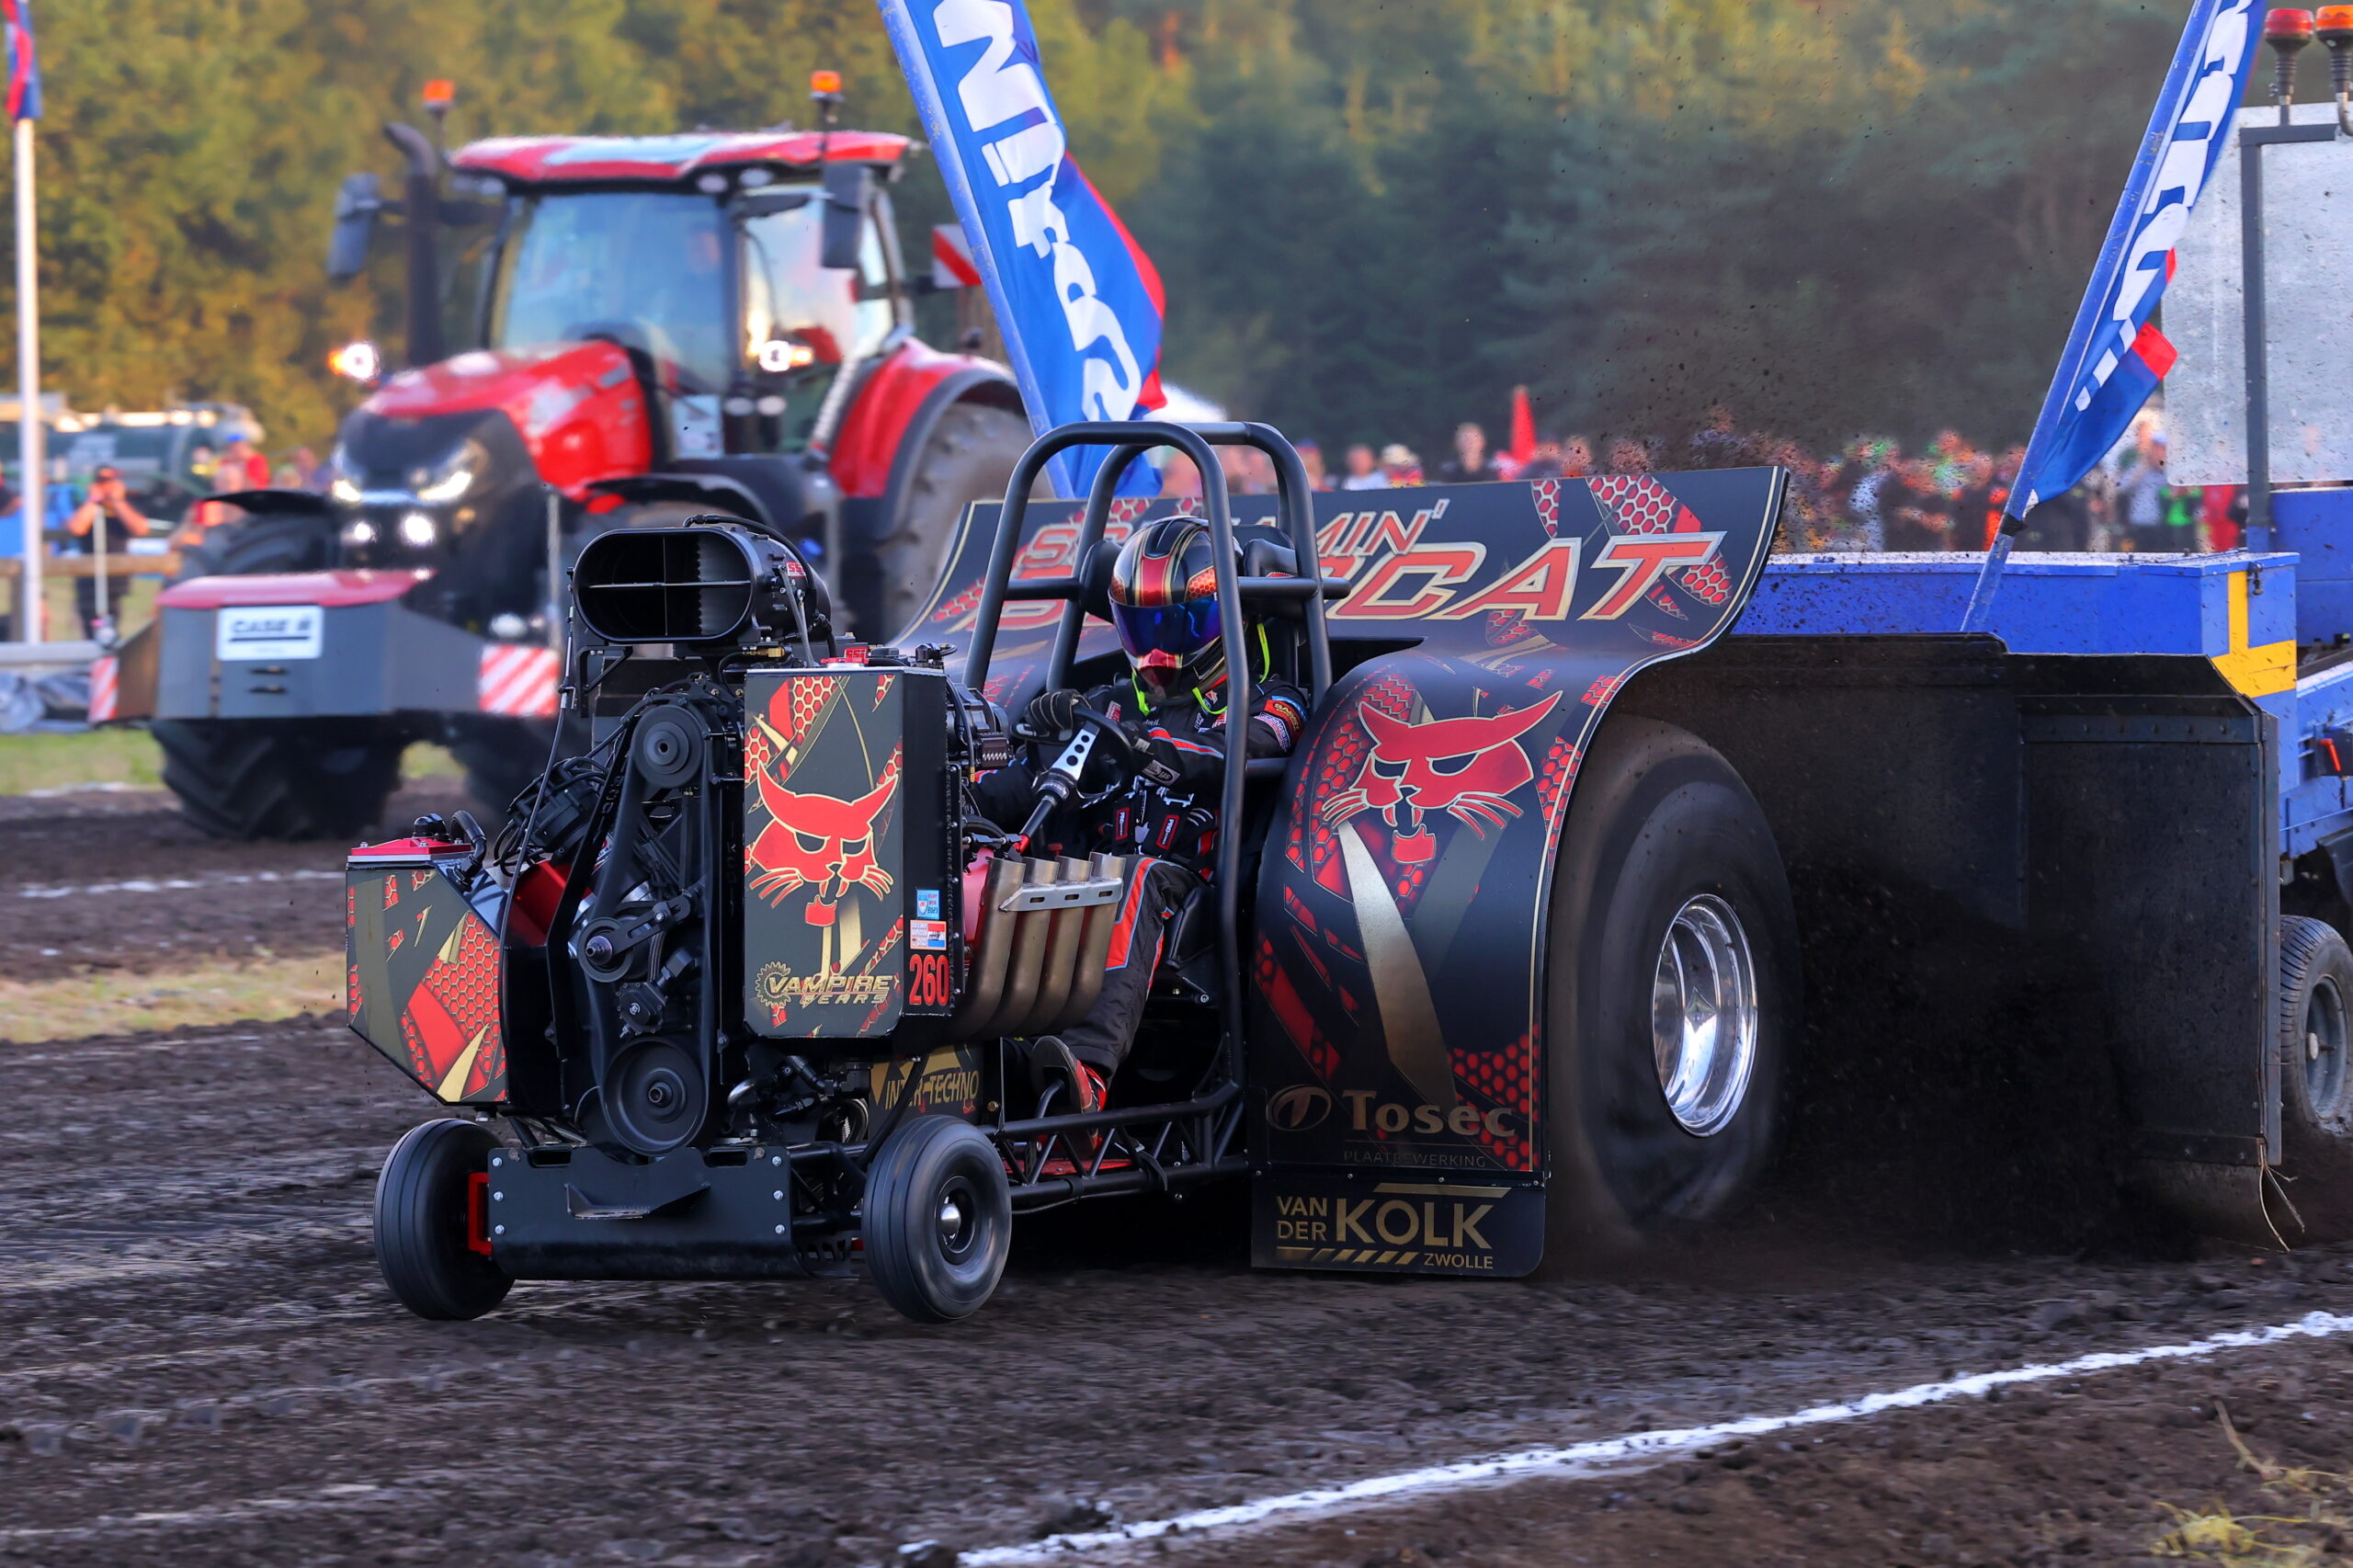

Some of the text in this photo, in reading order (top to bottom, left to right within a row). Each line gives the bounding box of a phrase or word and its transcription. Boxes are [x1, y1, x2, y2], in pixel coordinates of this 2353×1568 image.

[768, 975, 893, 994] VAMPIRE
[909, 953, 949, 1006] 260
[1341, 1088, 1517, 1138] Tosec
[1276, 1196, 1328, 1218] VAN
[1276, 1220, 1328, 1242] DER
[1336, 1198, 1495, 1250] KOLK
[1424, 1252, 1494, 1270] ZWOLLE
